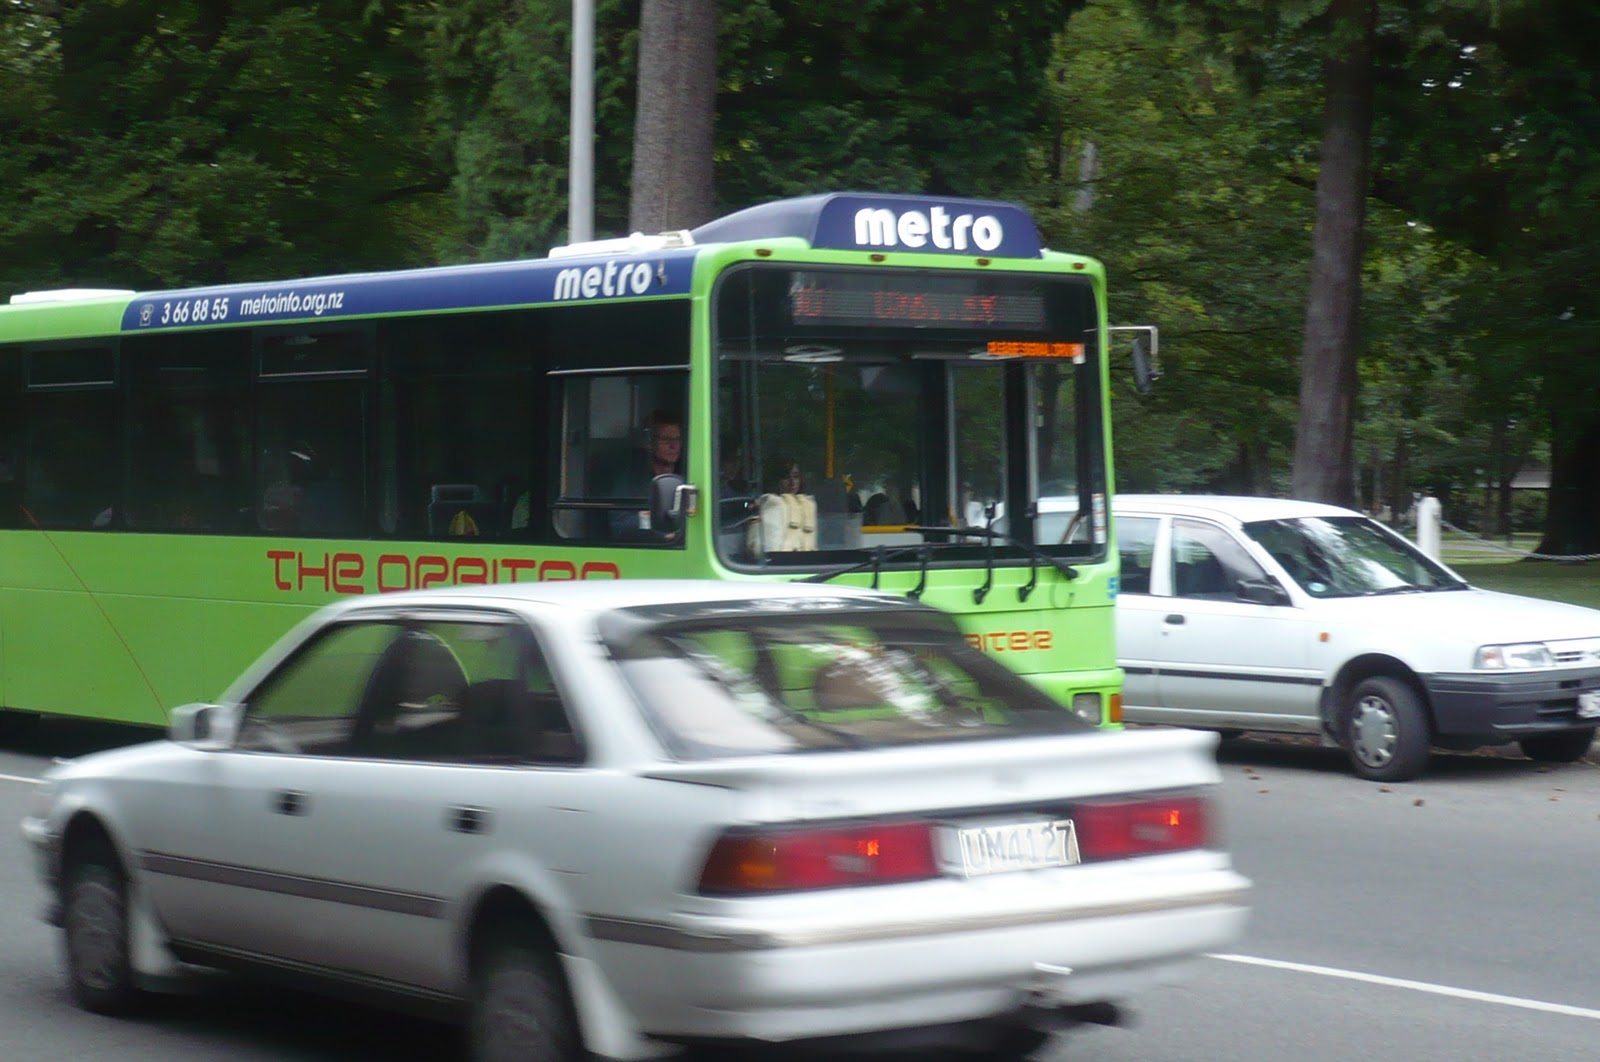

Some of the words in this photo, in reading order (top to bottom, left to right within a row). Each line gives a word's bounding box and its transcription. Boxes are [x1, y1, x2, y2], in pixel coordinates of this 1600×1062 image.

[854, 206, 1003, 251] metro
[553, 261, 653, 300] metro
[161, 302, 172, 324] 3
[173, 301, 190, 323] 66
[192, 300, 209, 321] 88
[211, 298, 229, 320] 55
[240, 291, 344, 316] metroinfo.org.nz
[267, 550, 364, 594] THE
